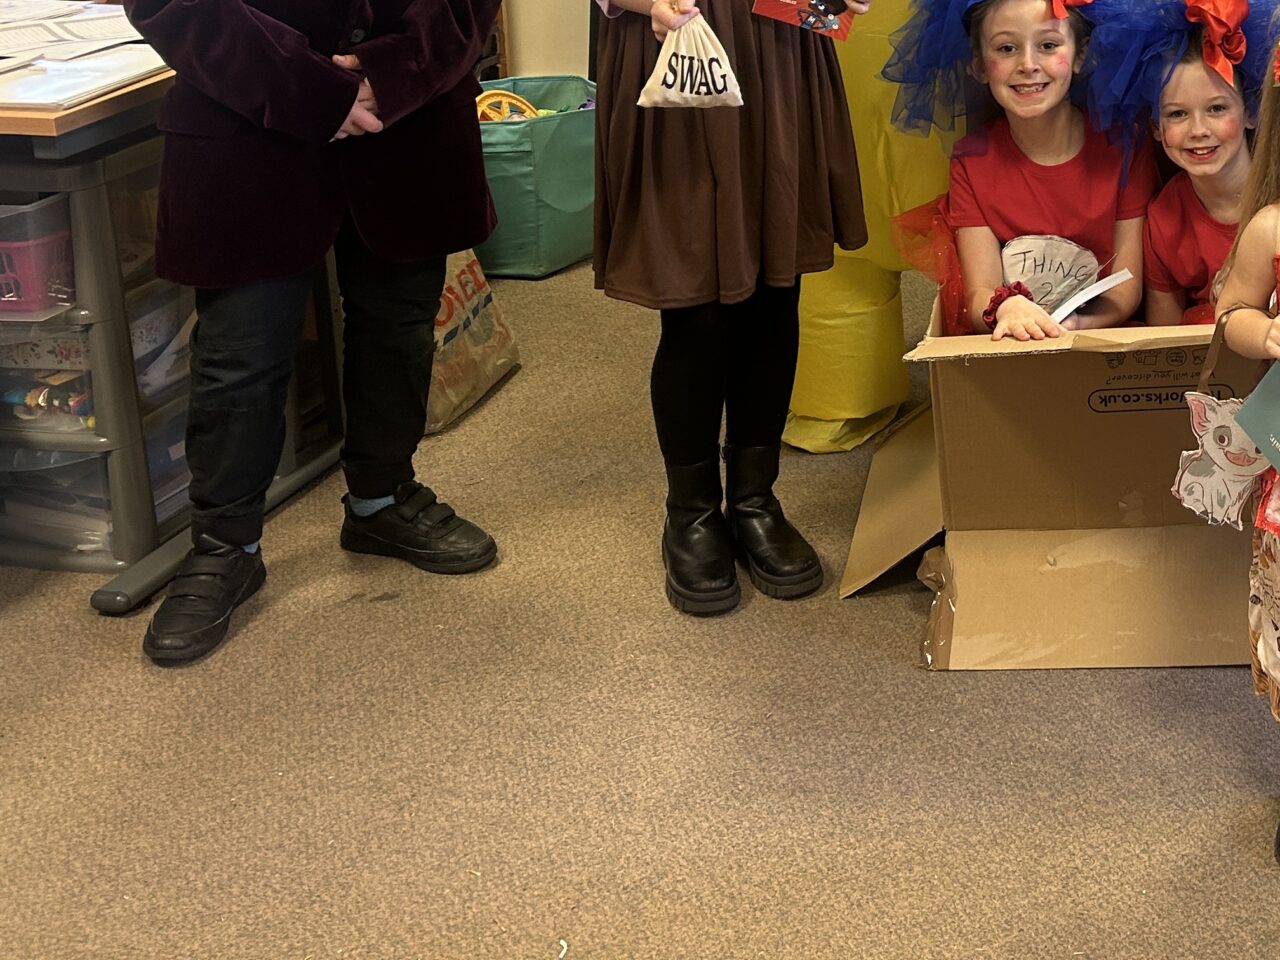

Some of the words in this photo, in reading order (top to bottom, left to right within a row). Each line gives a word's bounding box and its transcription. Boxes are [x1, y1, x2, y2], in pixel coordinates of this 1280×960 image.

[661, 51, 728, 96] SWAG
[1011, 249, 1089, 280] THING
[1036, 282, 1054, 307] 2
